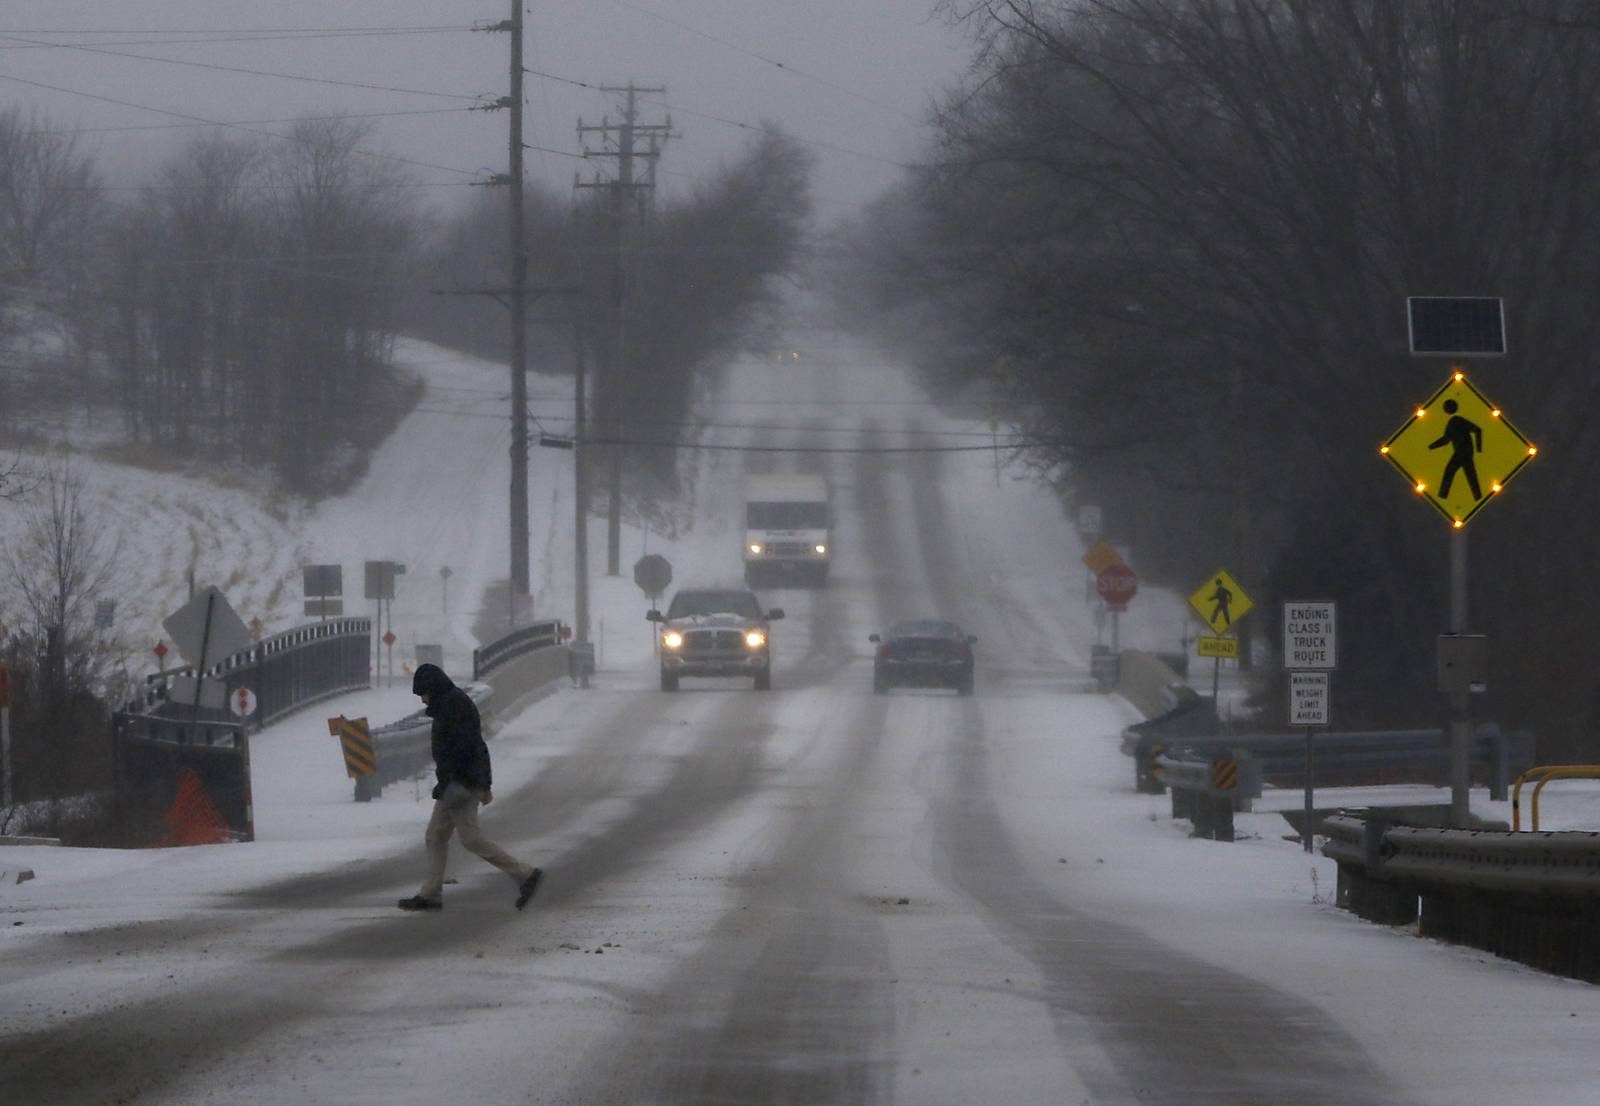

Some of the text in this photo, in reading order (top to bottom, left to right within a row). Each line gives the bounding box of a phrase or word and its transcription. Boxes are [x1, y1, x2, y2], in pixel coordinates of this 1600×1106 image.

[1291, 609, 1329, 620] ENDING
[1288, 623, 1320, 634] CLASS
[1202, 641, 1234, 654] AHEAD
[1293, 637, 1326, 648] TRUCK
[1294, 650, 1326, 661] ROUTE
[1297, 711, 1322, 720] AHEAD
